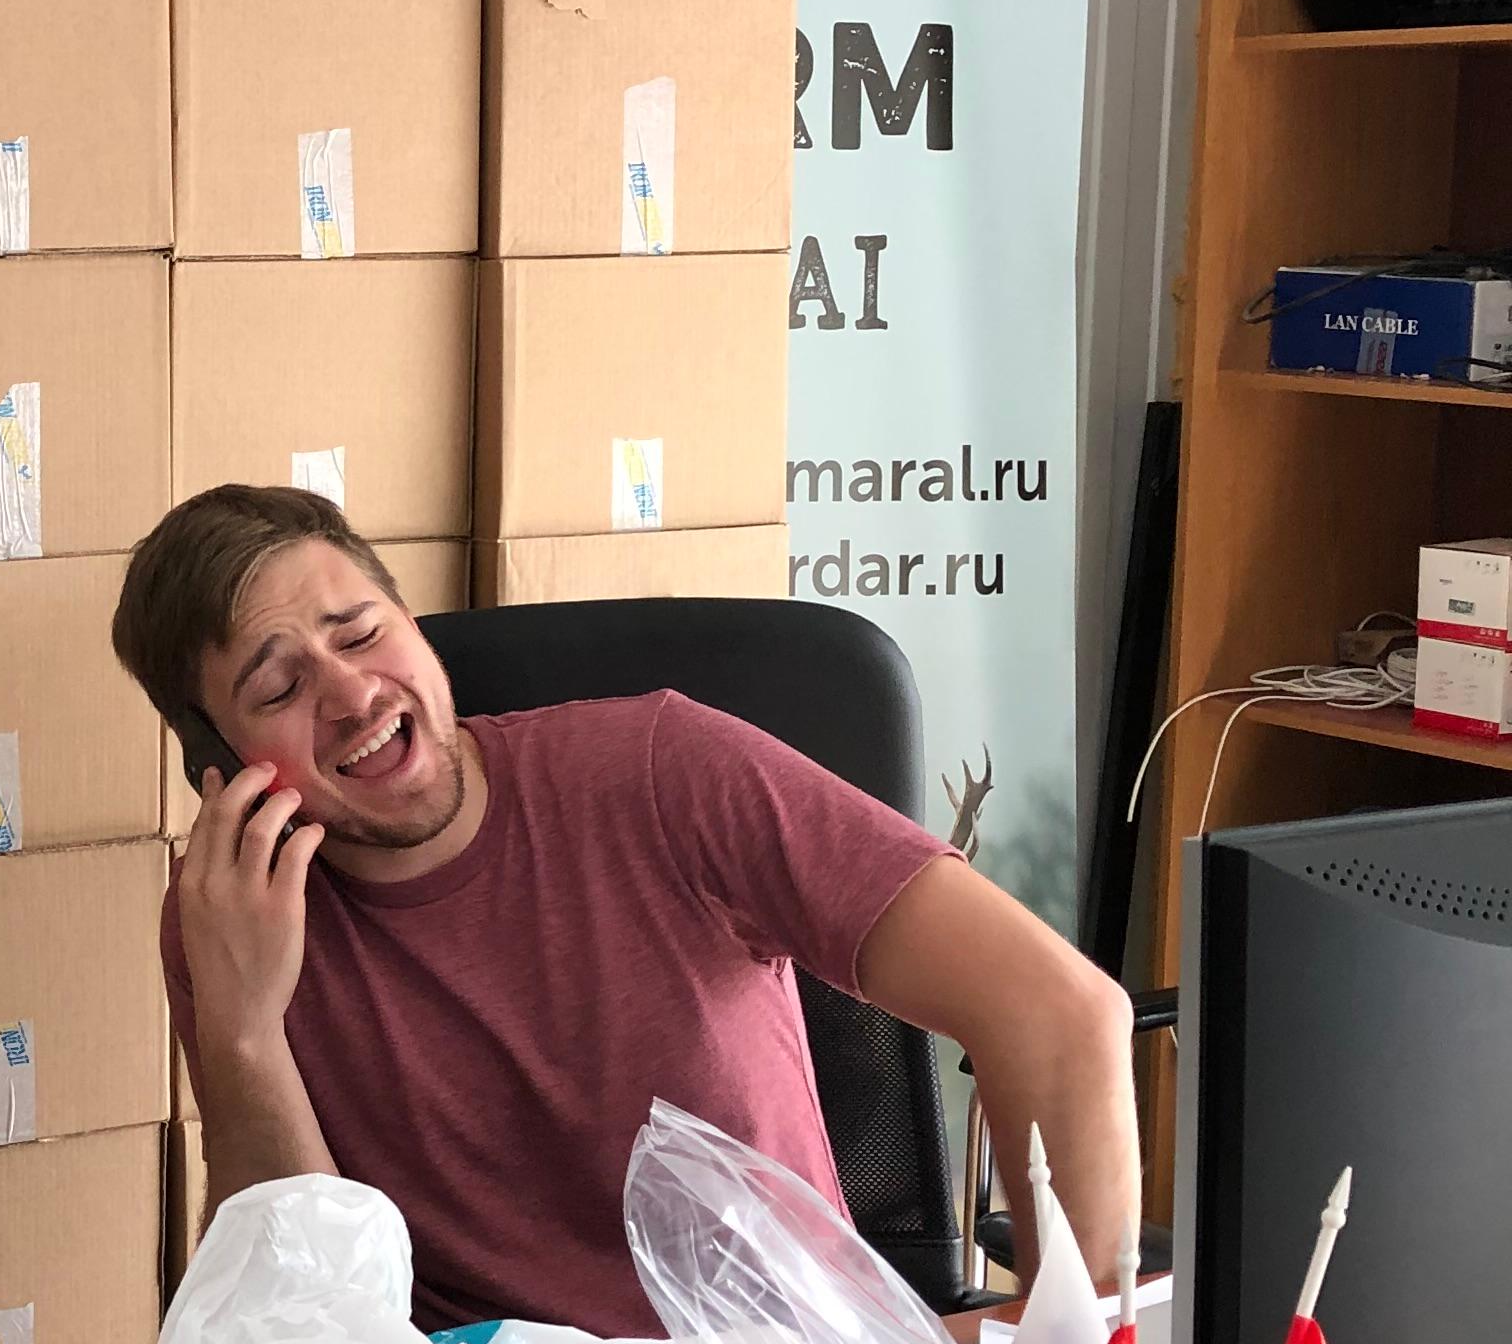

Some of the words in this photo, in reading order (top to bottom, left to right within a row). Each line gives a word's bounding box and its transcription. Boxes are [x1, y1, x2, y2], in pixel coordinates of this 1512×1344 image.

[1324, 313, 1358, 331] LAN
[1361, 316, 1420, 336] CABLE
[787, 444, 1048, 503] maral.ru
[632, 484, 658, 520] IRON
[789, 539, 1004, 597] rdar.ru
[0, 1029, 28, 1067] IRON
